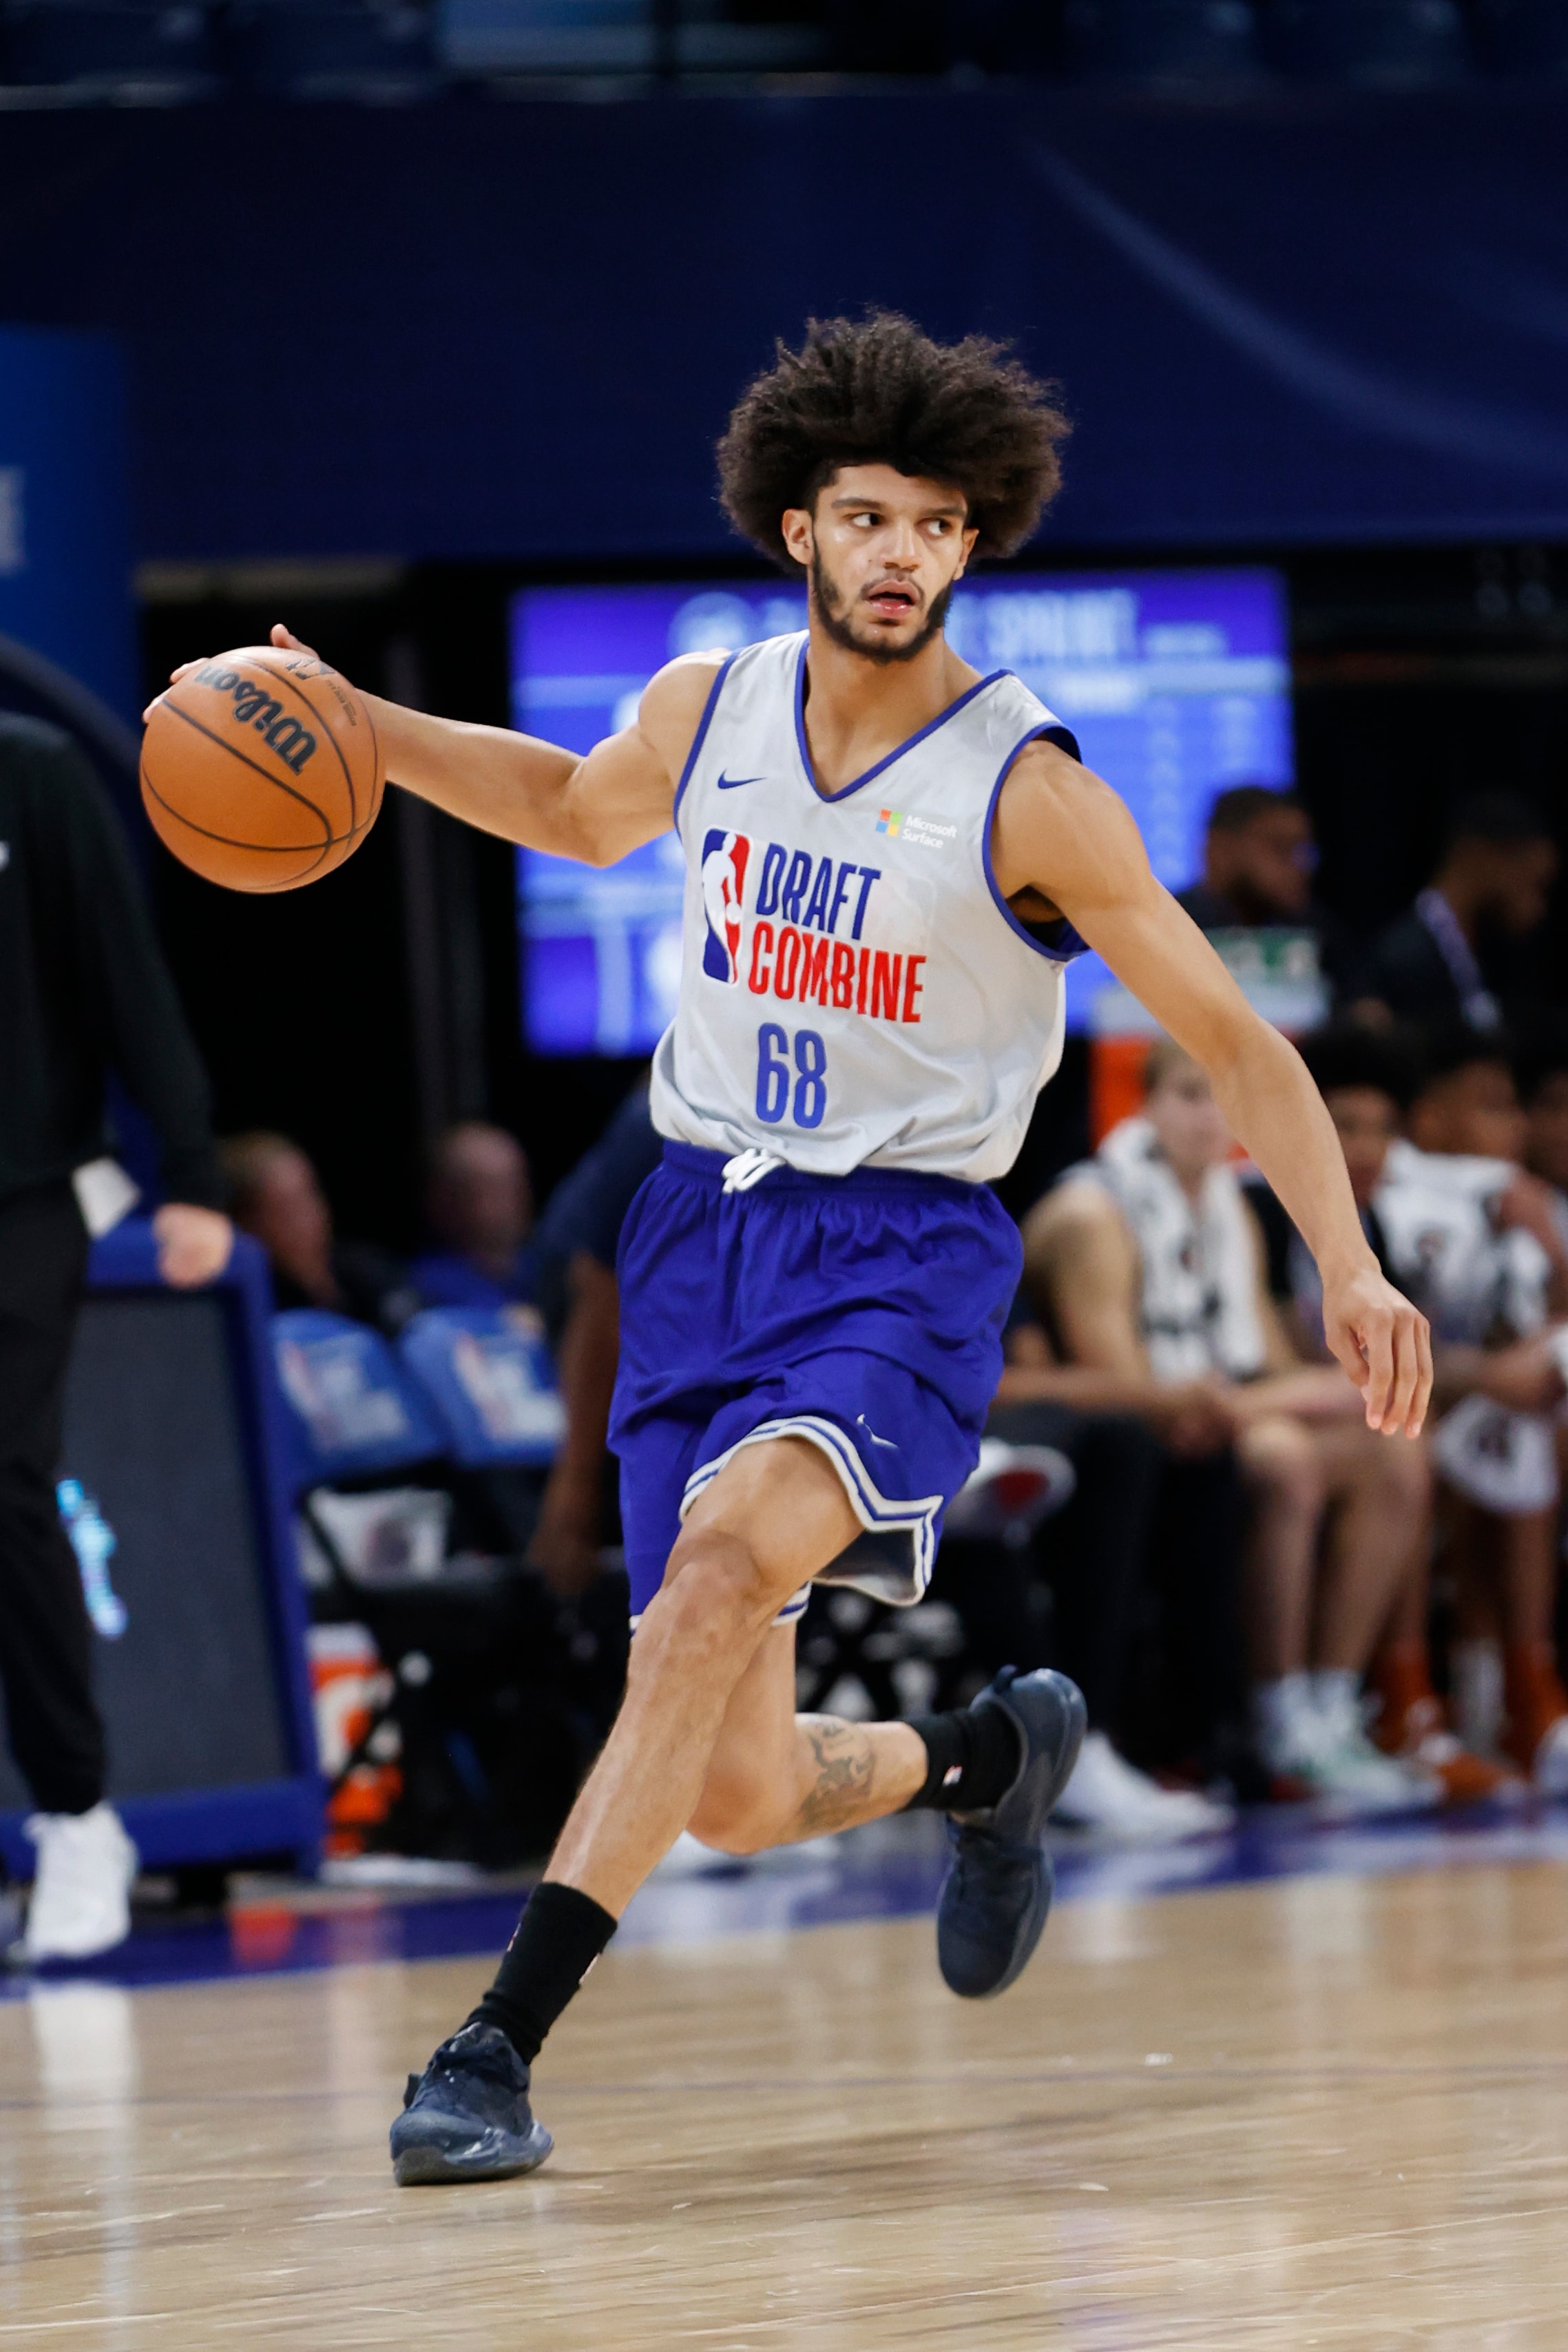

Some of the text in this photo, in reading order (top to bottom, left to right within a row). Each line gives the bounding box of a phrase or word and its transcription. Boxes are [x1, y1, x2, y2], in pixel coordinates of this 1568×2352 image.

[194, 665, 318, 776] Wilson
[902, 829, 944, 848] Surface
[906, 815, 957, 837] Microsoft
[755, 842, 881, 940] DRAFT
[749, 921, 927, 1023] COMBINE
[756, 1023, 827, 1129] 68
